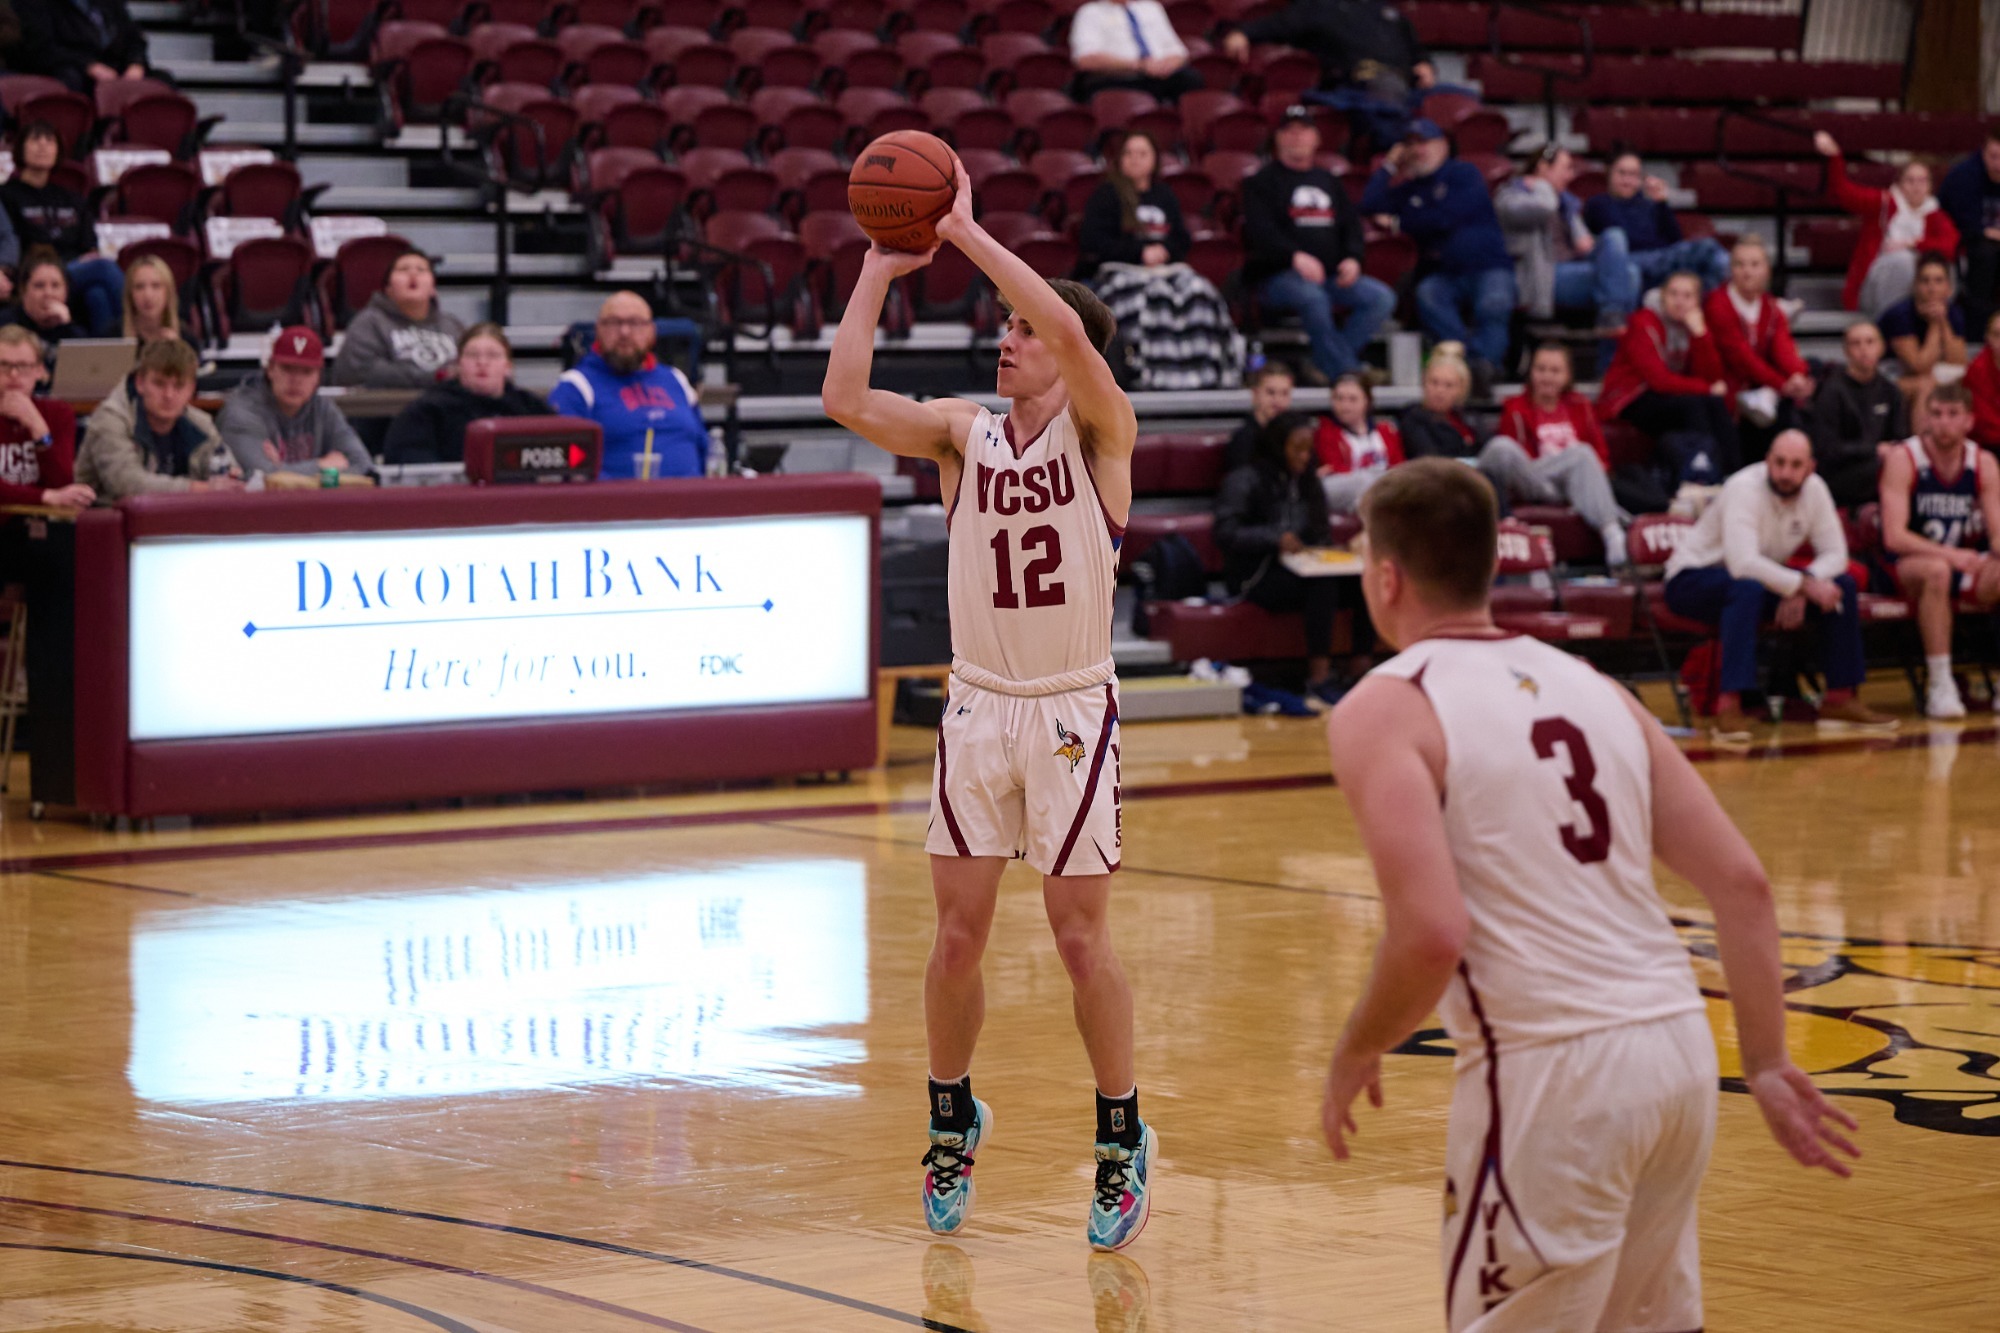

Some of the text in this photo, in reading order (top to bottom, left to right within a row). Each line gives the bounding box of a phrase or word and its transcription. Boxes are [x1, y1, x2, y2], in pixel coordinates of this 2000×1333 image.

[977, 453, 1076, 516] VCSU
[296, 549, 723, 612] DACOTAH BANK
[990, 524, 1066, 608] 12
[384, 648, 482, 691] Here
[569, 652, 647, 695] you.
[1531, 716, 1611, 865] 3
